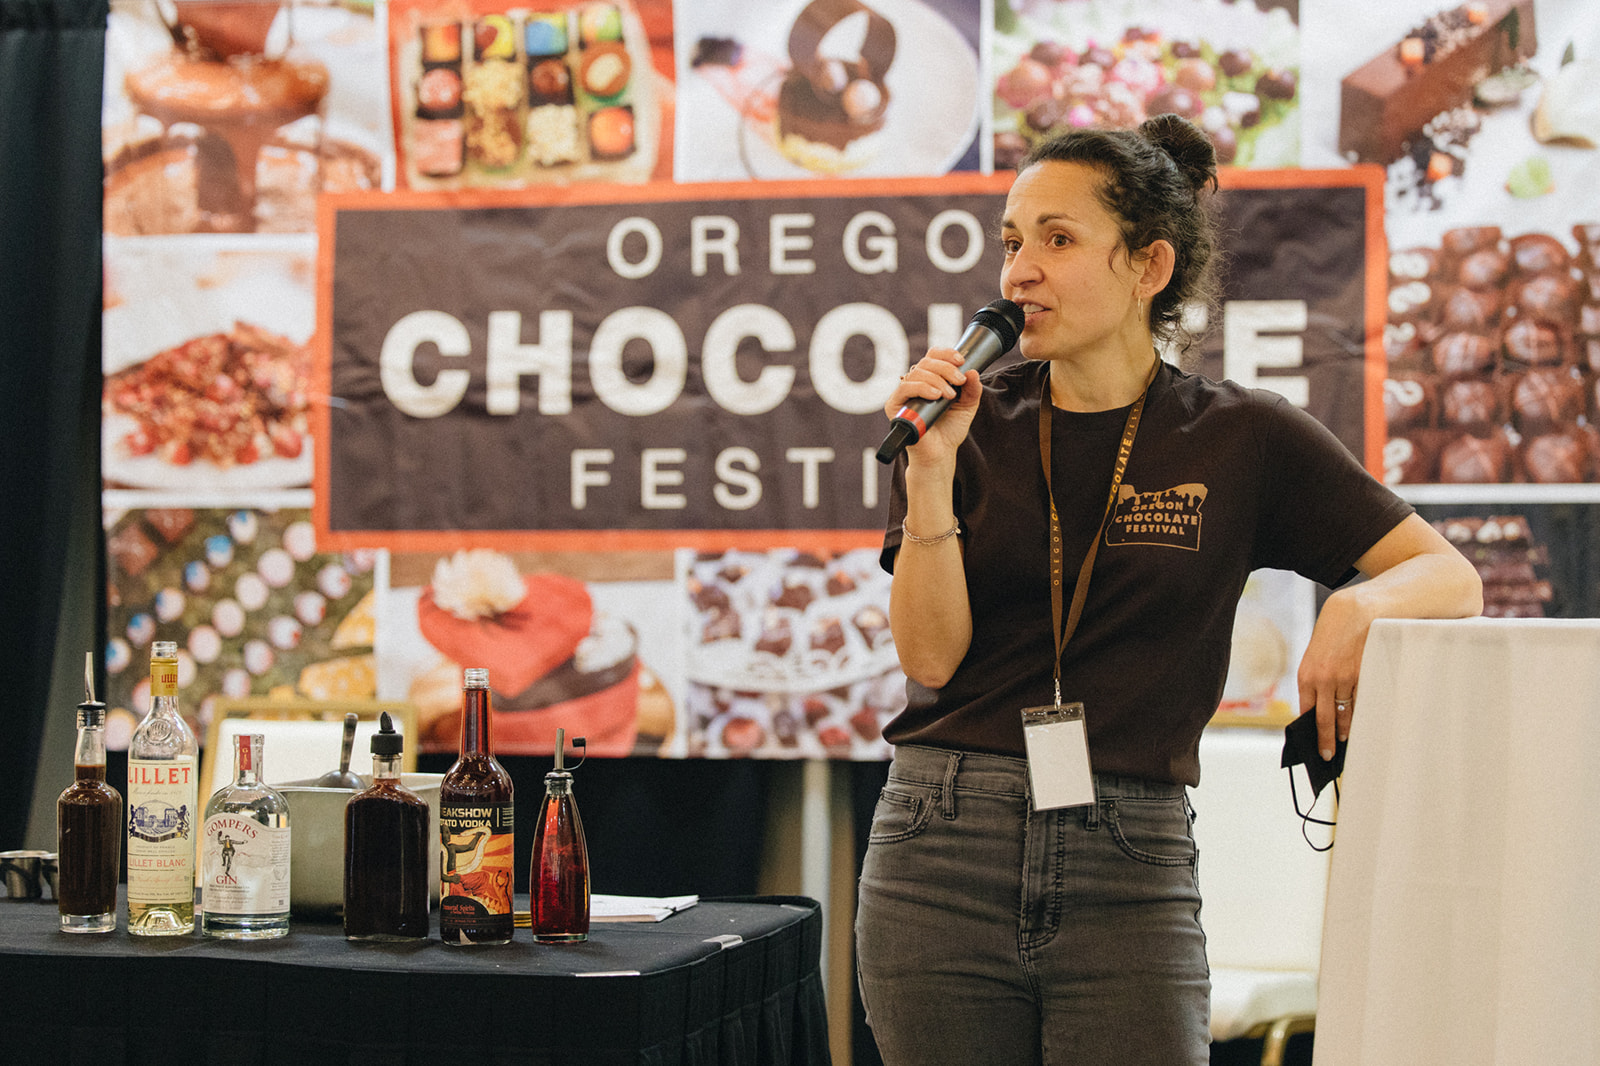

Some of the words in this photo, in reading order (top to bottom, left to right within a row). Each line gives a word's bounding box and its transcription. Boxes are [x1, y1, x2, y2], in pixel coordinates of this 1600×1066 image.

[606, 209, 985, 280] OREGO
[379, 300, 1310, 419] CHOCOE
[571, 446, 879, 510] FESTI
[1131, 501, 1184, 511] OREGON
[1115, 512, 1198, 525] CHOCOLATE
[1126, 524, 1185, 535] FESTIVAL
[128, 766, 191, 784] LILLET
[441, 808, 493, 818] EAKSHOW
[207, 819, 259, 839] GOMPERS
[459, 819, 492, 828] VODKA
[156, 858, 187, 868] BLANC
[216, 875, 238, 885] GIN
